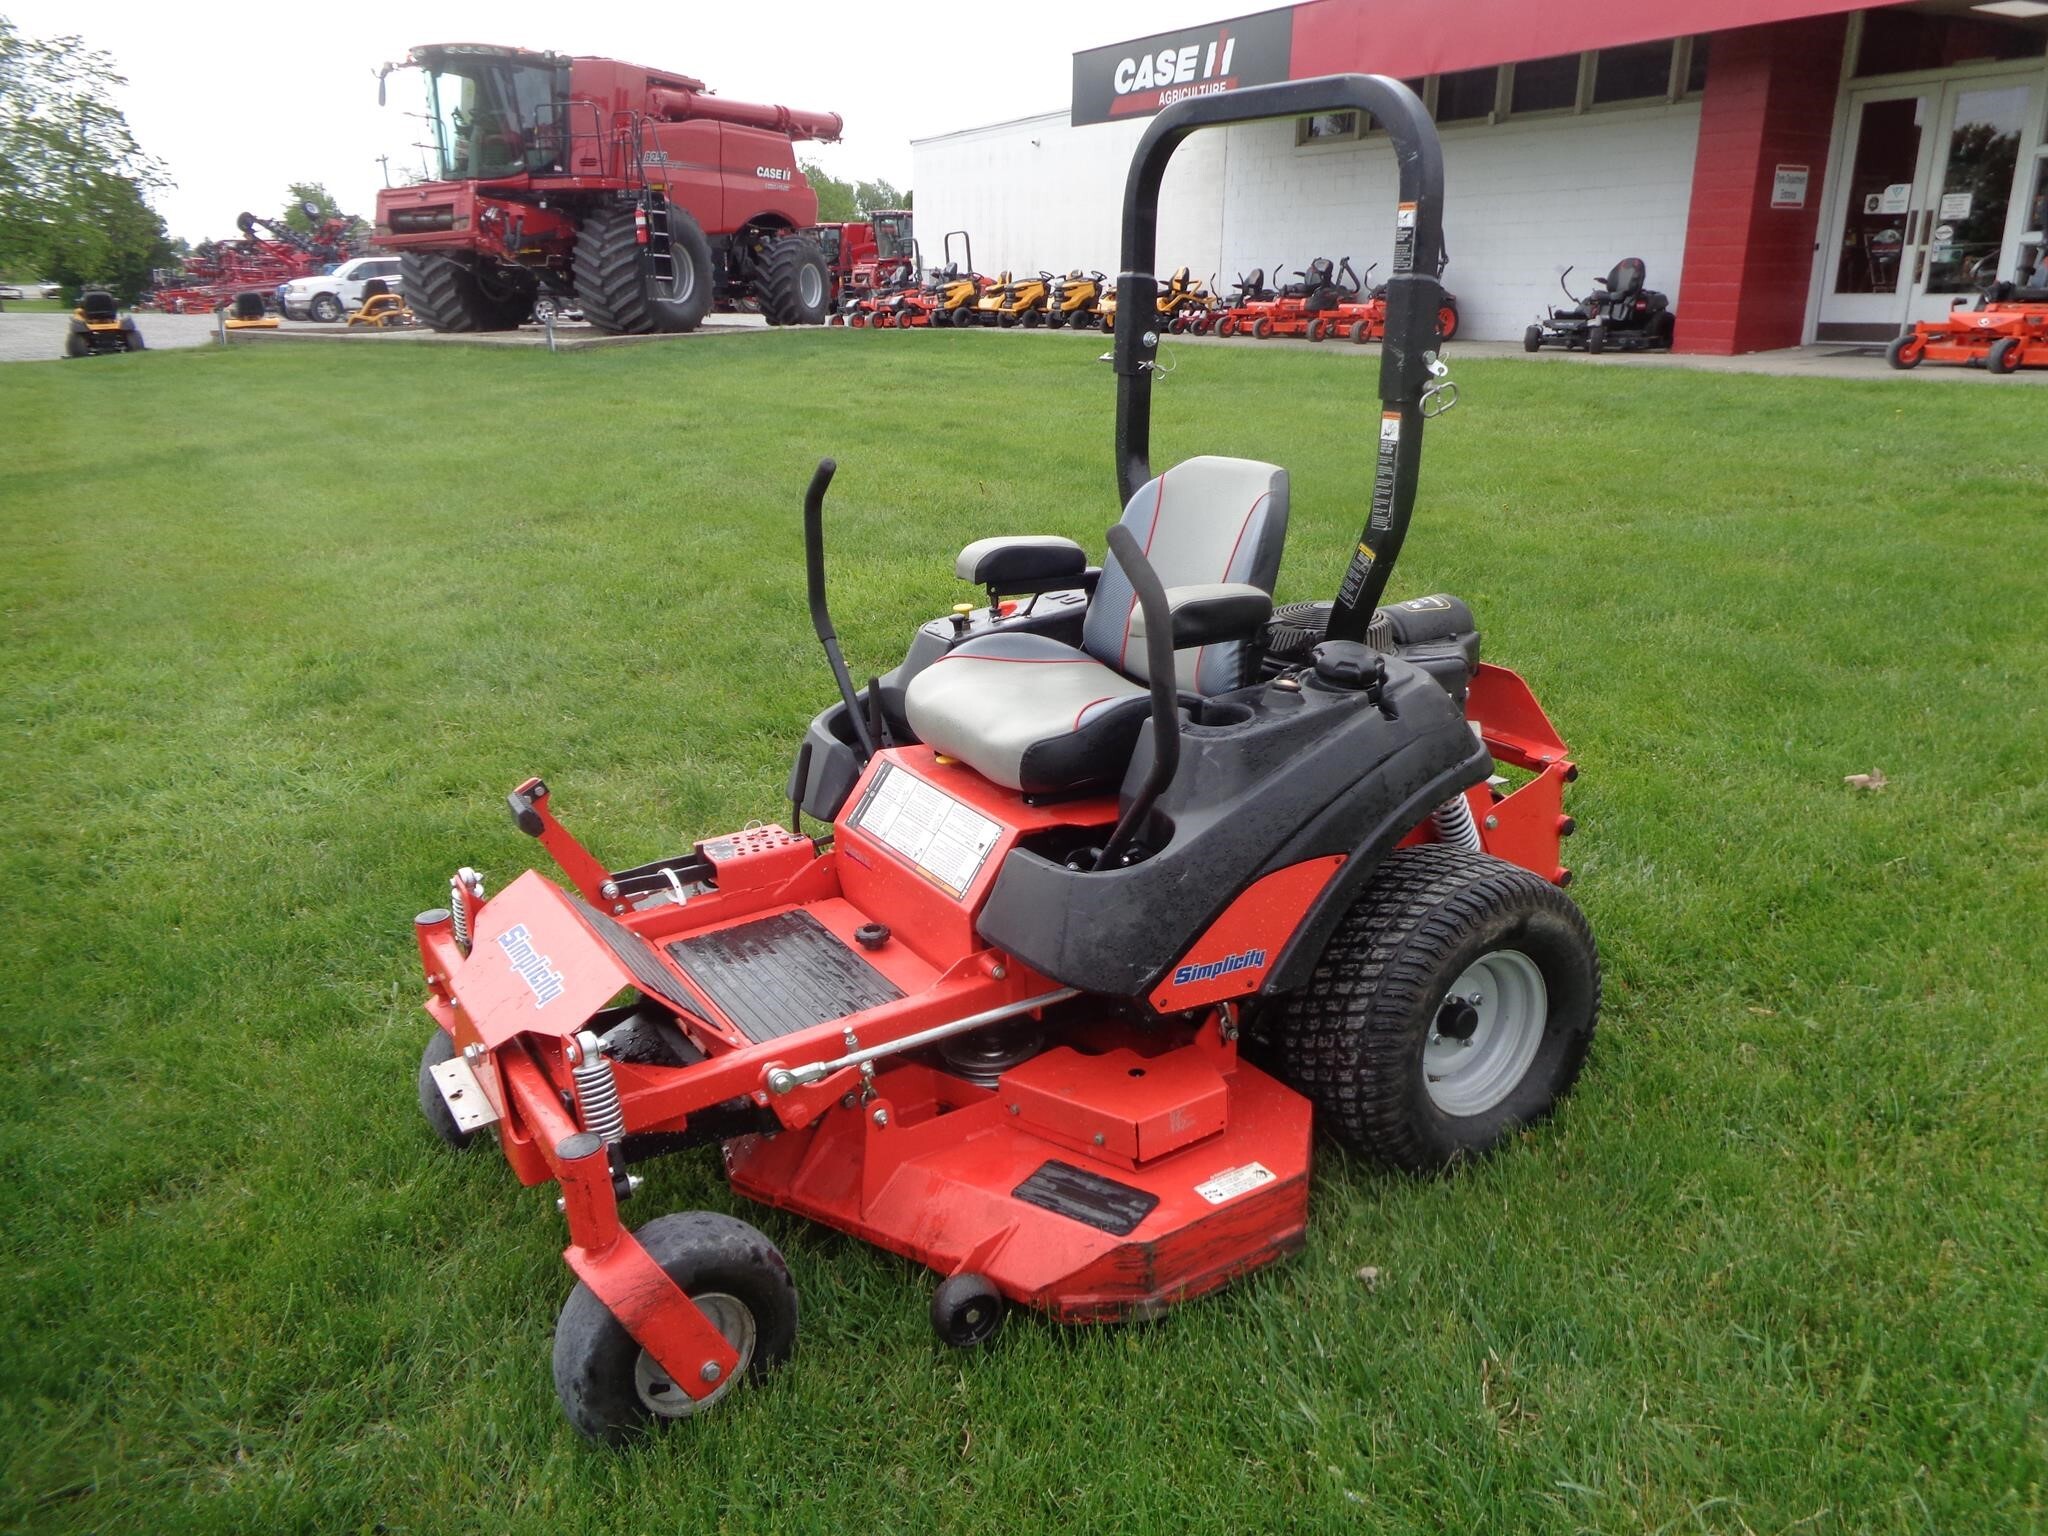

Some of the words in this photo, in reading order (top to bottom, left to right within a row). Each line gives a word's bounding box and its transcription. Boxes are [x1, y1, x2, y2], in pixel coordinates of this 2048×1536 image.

[1113, 45, 1200, 94] CASE
[1158, 82, 1227, 106] AGRICULTURE
[756, 166, 782, 180] CASE
[497, 923, 565, 1010] Simplicity
[1173, 948, 1267, 986] Simplicity
